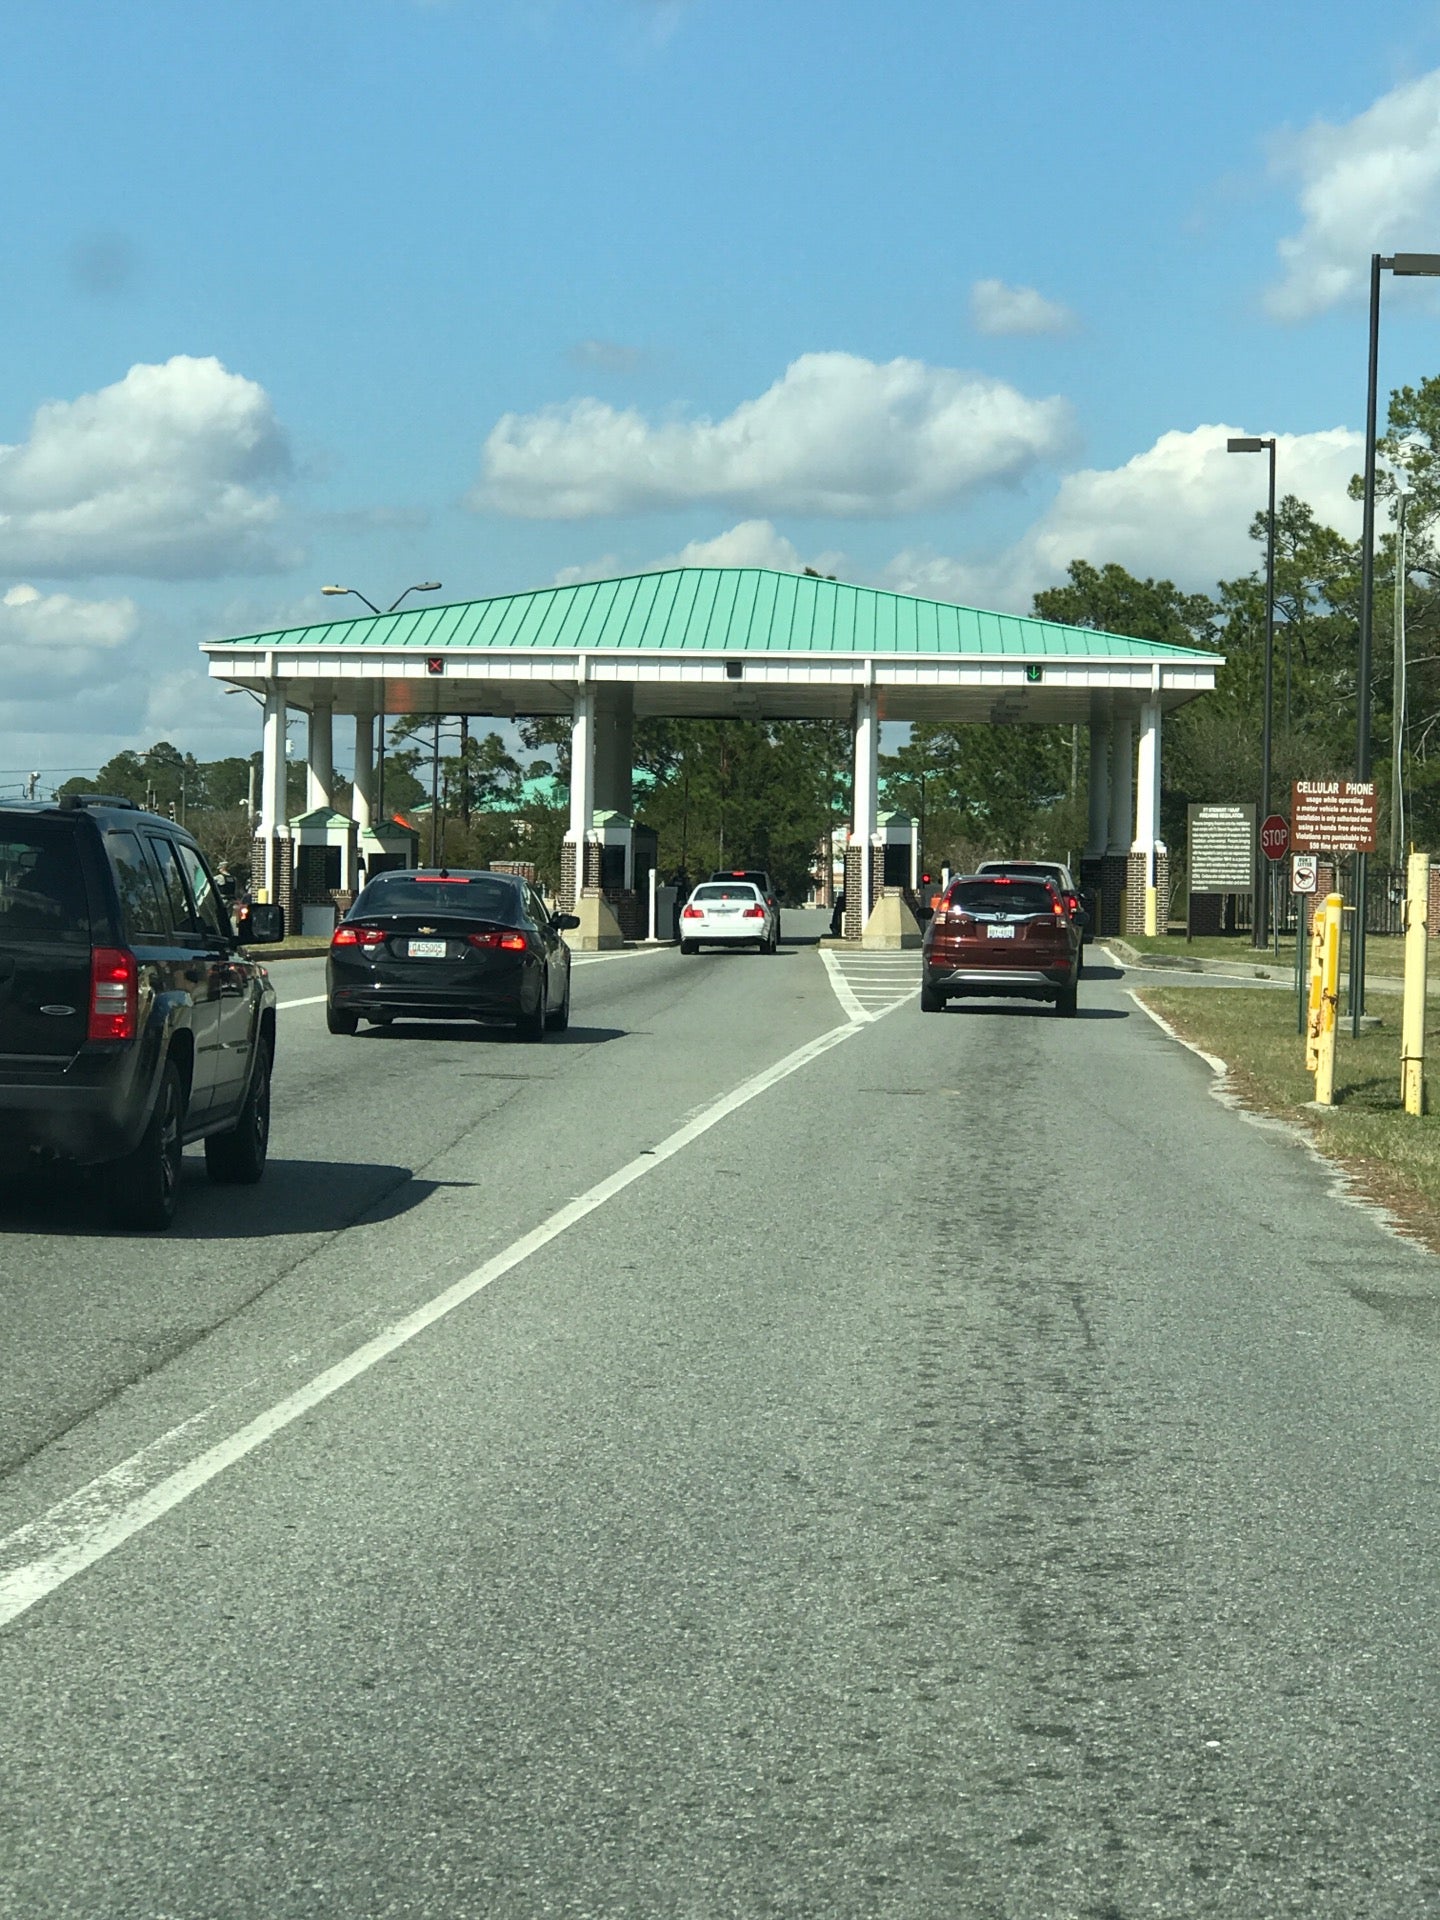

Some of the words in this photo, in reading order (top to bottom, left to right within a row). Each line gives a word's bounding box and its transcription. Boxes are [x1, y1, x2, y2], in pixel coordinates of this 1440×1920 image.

[1297, 782, 1339, 794] CELLULAR
[1346, 783, 1373, 795] PHONE
[1339, 797, 1363, 805] operating
[1326, 815, 1336, 823] only
[1298, 824, 1313, 832] using
[1263, 829, 1287, 847] STOP
[1361, 835, 1367, 843] by
